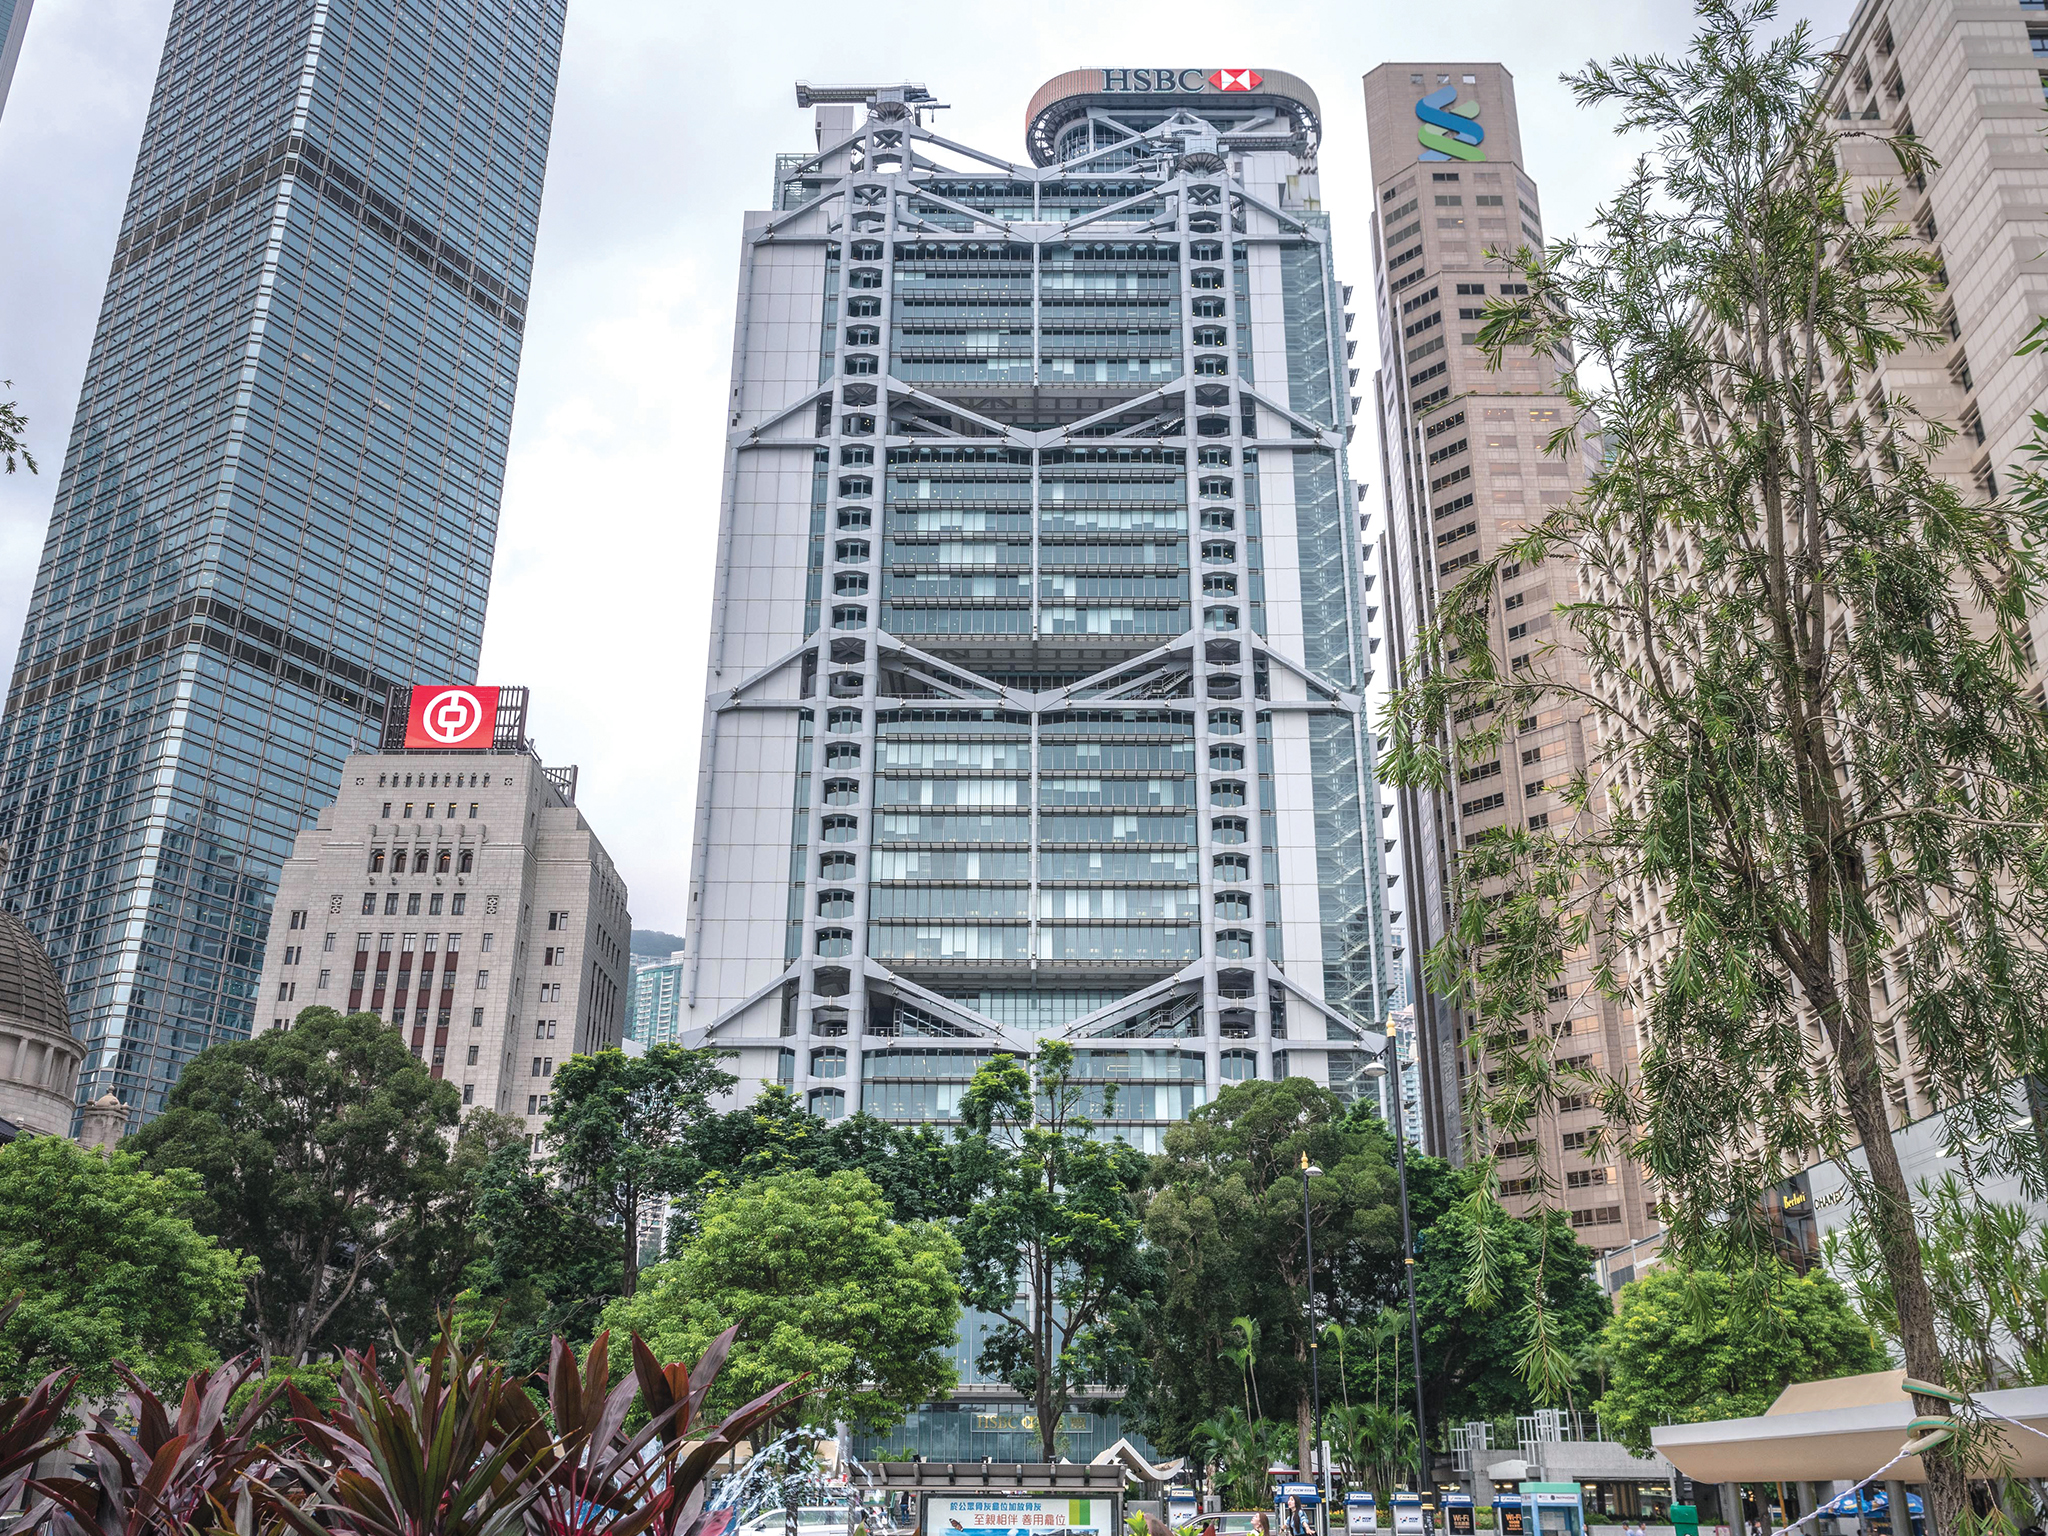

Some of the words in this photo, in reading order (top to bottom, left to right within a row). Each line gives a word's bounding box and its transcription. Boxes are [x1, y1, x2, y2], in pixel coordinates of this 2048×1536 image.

[1101, 68, 1206, 93] HSBC
[1783, 1191, 1806, 1209] Berluti
[1814, 1190, 1846, 1210] CHANEL
[976, 1415, 1019, 1429] HSBC
[974, 1513, 1018, 1526] 至親相伴
